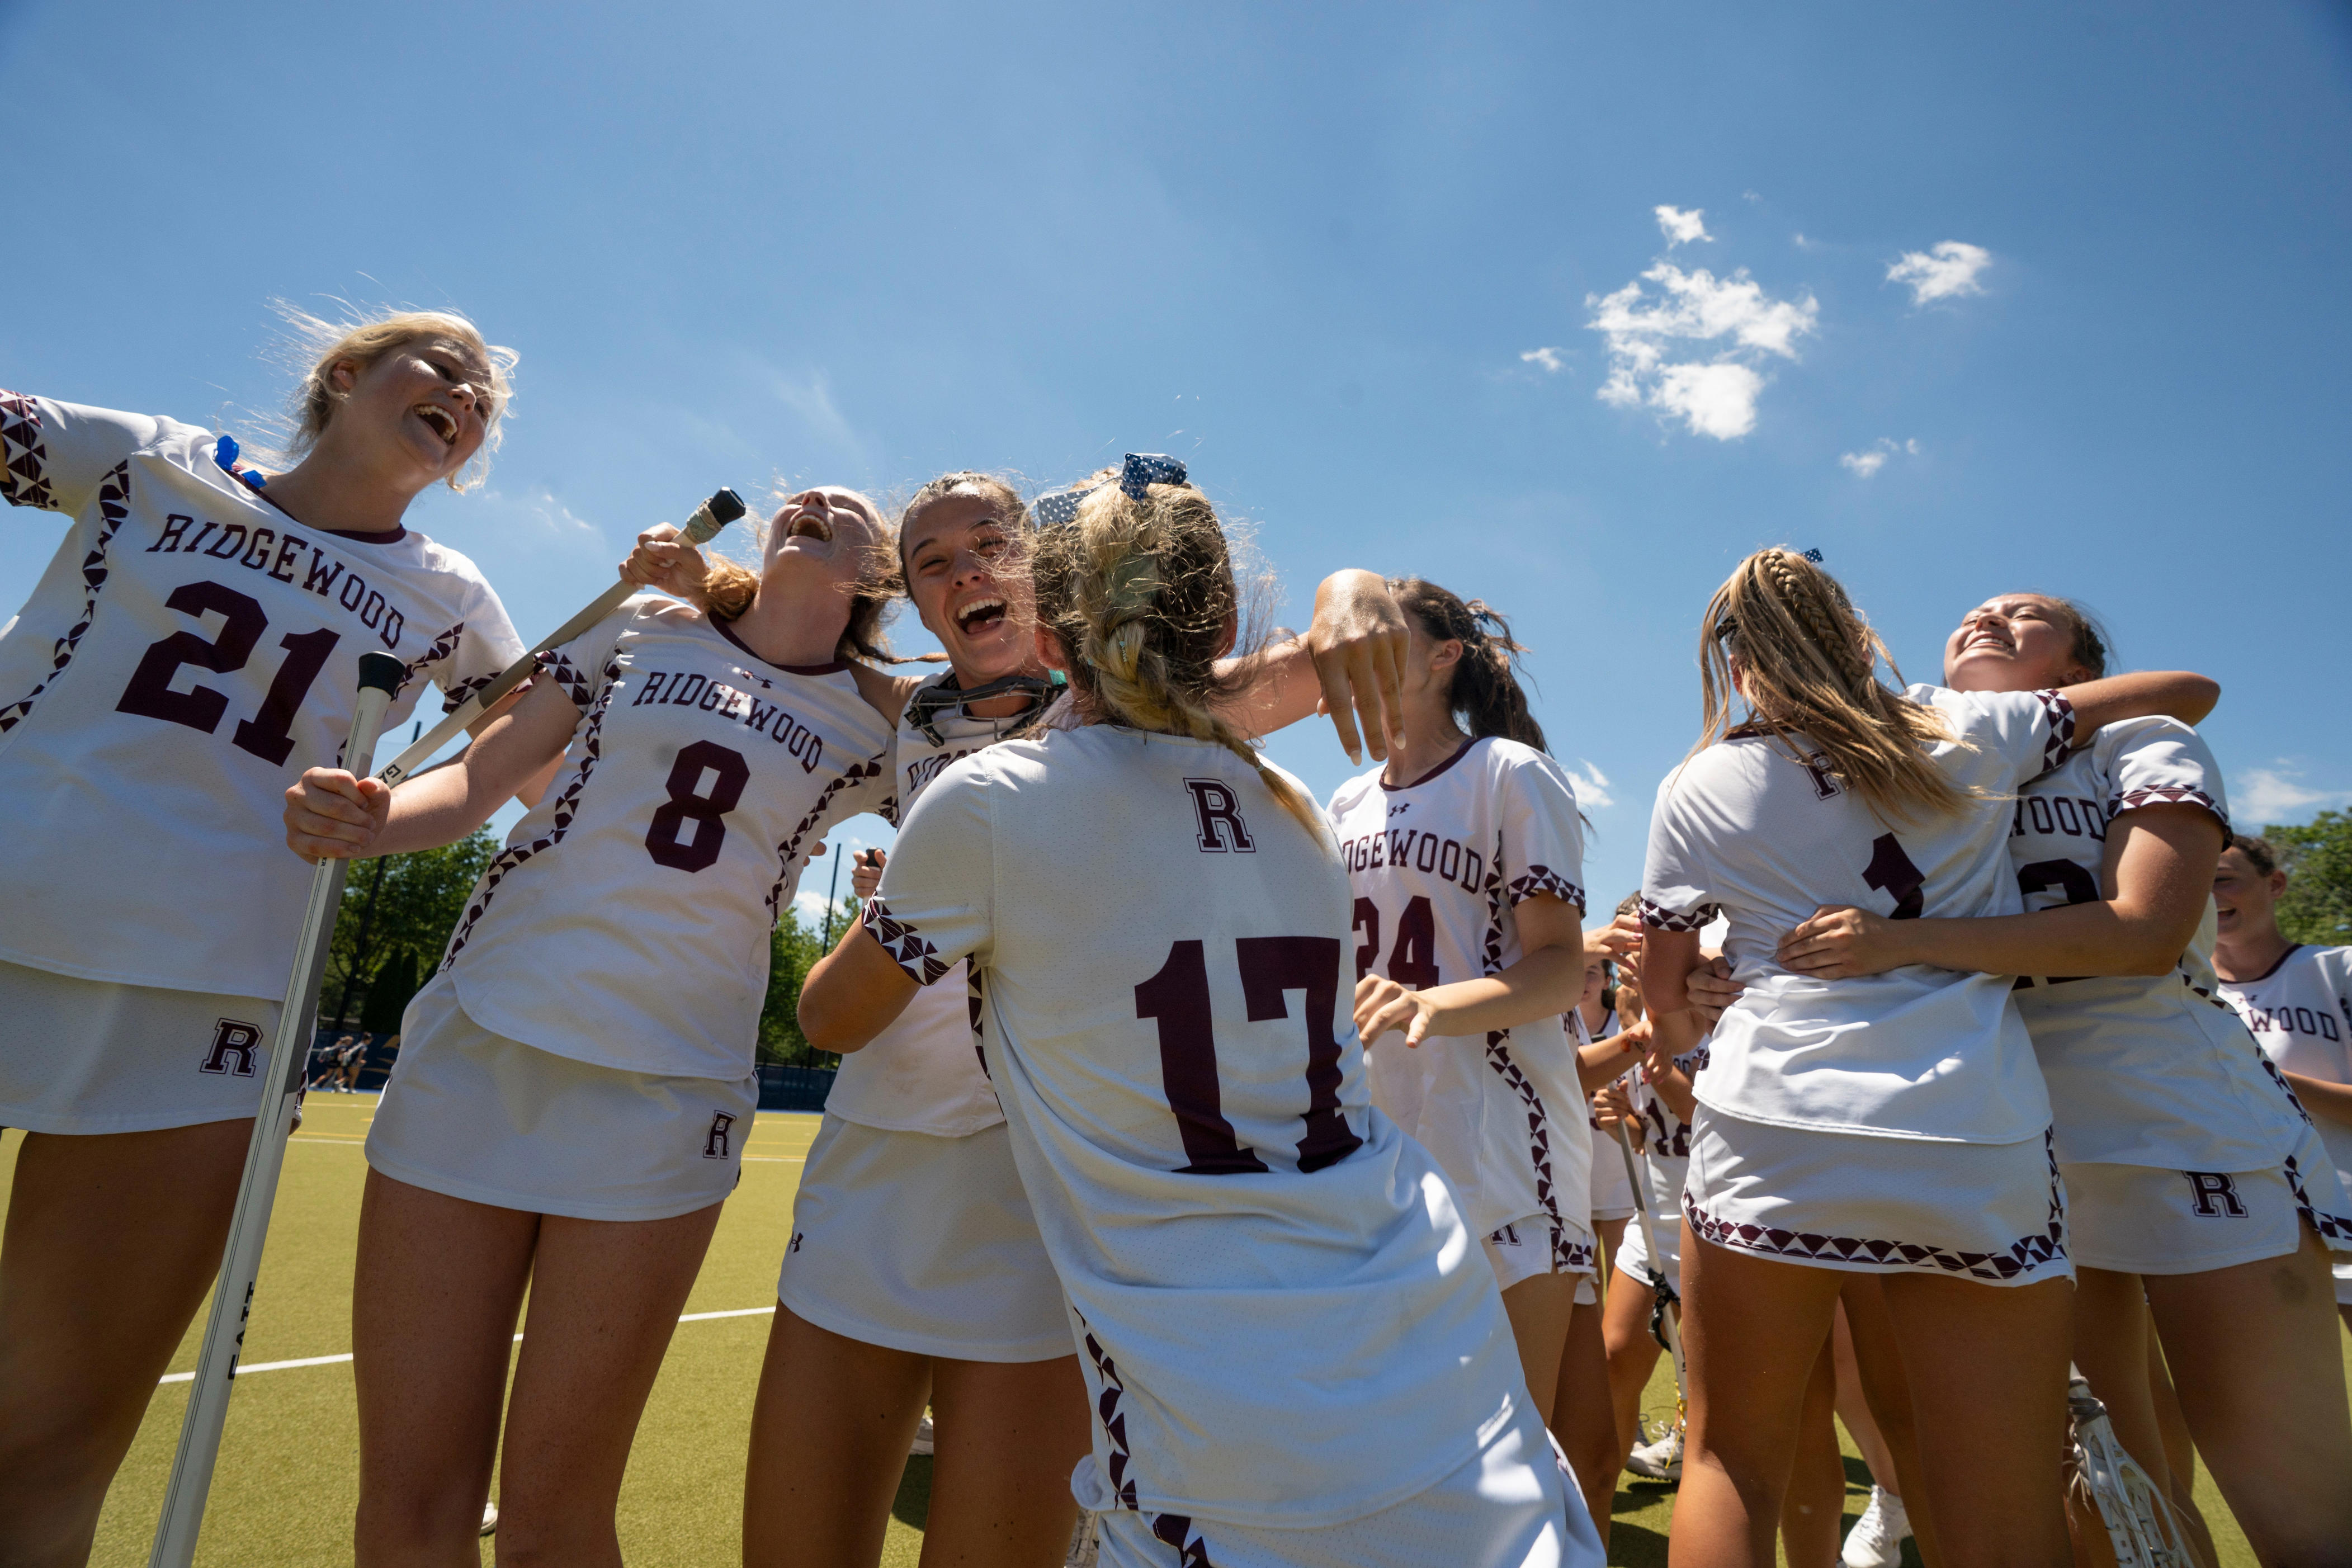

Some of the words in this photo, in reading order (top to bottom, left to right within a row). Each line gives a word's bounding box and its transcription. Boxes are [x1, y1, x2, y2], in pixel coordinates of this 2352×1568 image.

[146, 513, 404, 649] RIDGEWOOD
[115, 580, 341, 767] 21
[632, 671, 823, 774] RIDGEWOOD
[644, 739, 750, 873] 8
[1182, 777, 1256, 853] R
[1352, 895, 1439, 992] 24
[199, 1018, 264, 1078] R
[1134, 936, 1364, 1174] 17
[702, 1109, 737, 1160] R
[2181, 1169, 2249, 1218] R
